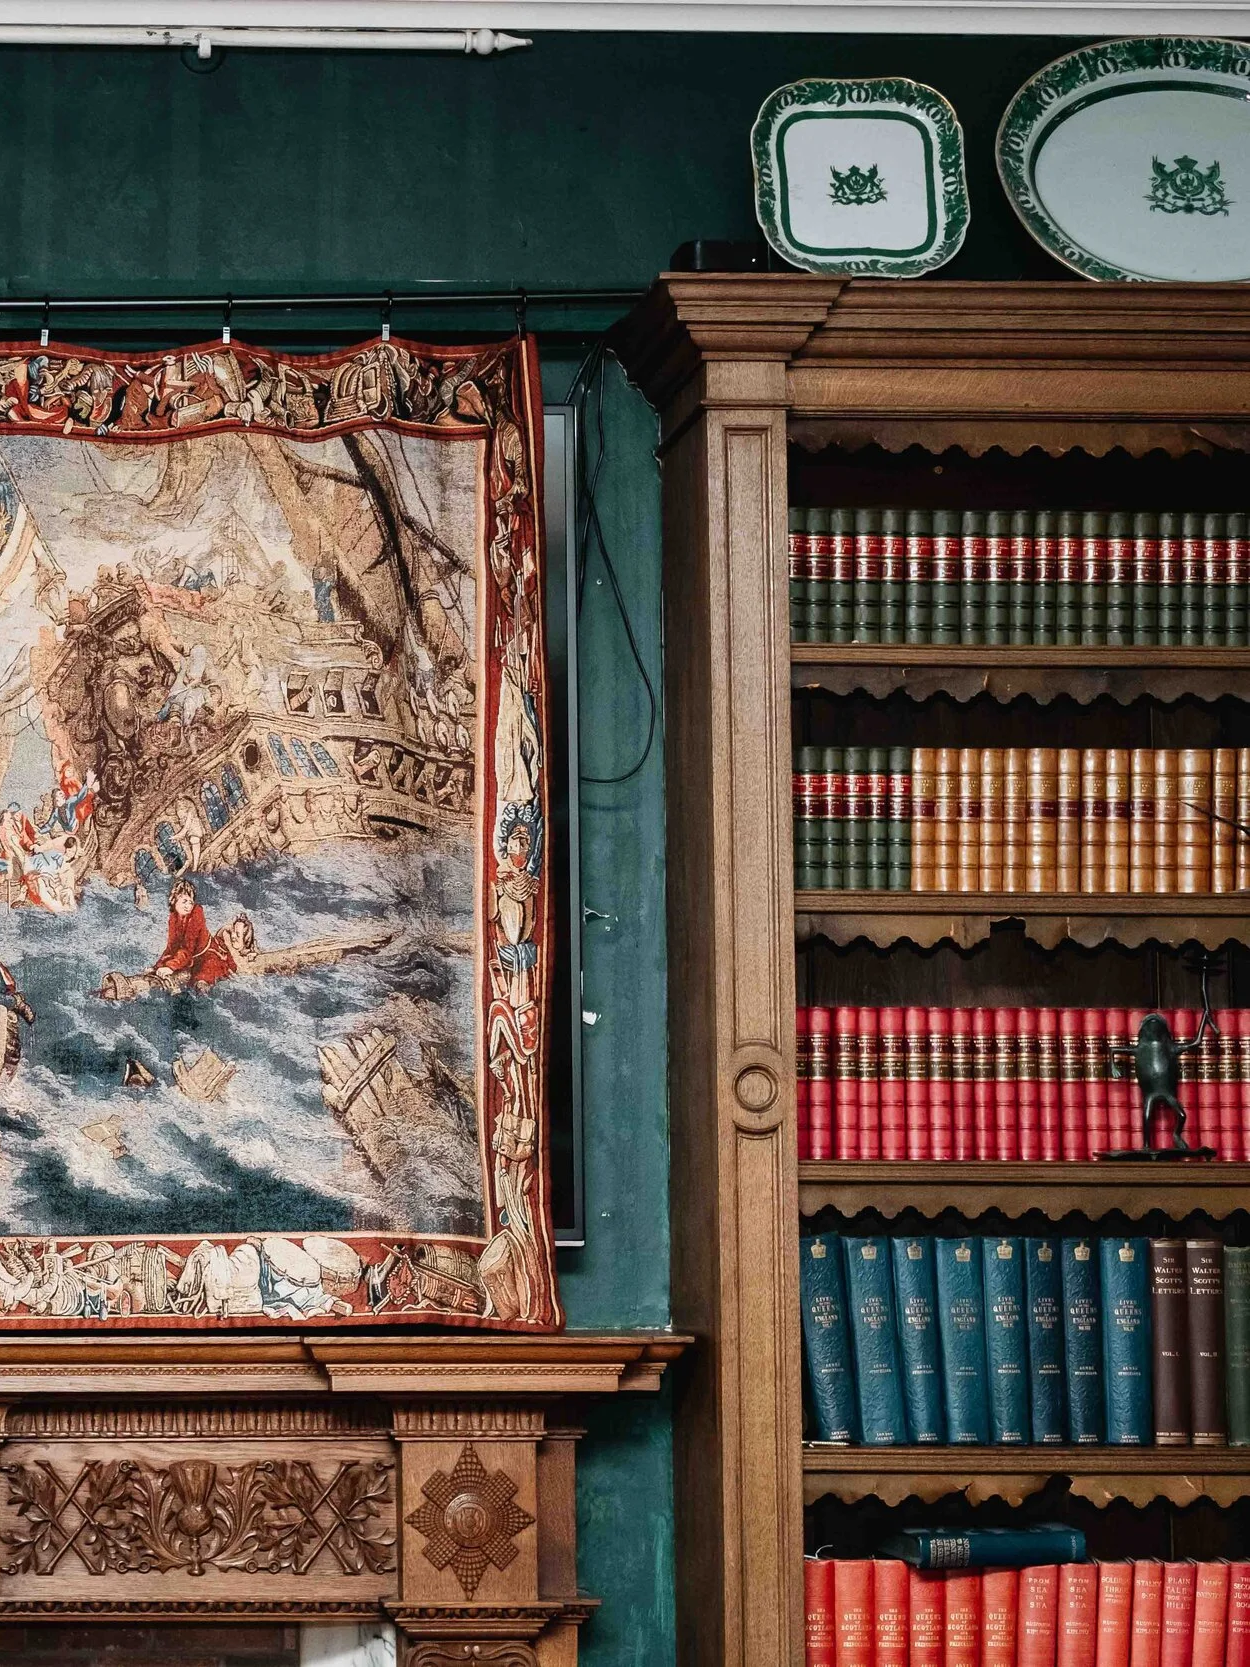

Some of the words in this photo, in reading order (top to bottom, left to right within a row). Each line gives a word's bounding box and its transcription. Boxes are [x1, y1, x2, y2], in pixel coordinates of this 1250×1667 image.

[1153, 1266, 1183, 1274] WALTER
[1191, 1266, 1221, 1274] WALTER
[1151, 1286, 1186, 1295] LETTERS
[1190, 1286, 1223, 1295] LETTERS
[1168, 1576, 1191, 1585] PLAIN
[1165, 1586, 1190, 1594] TALE
[1069, 1601, 1087, 1609] SEA
